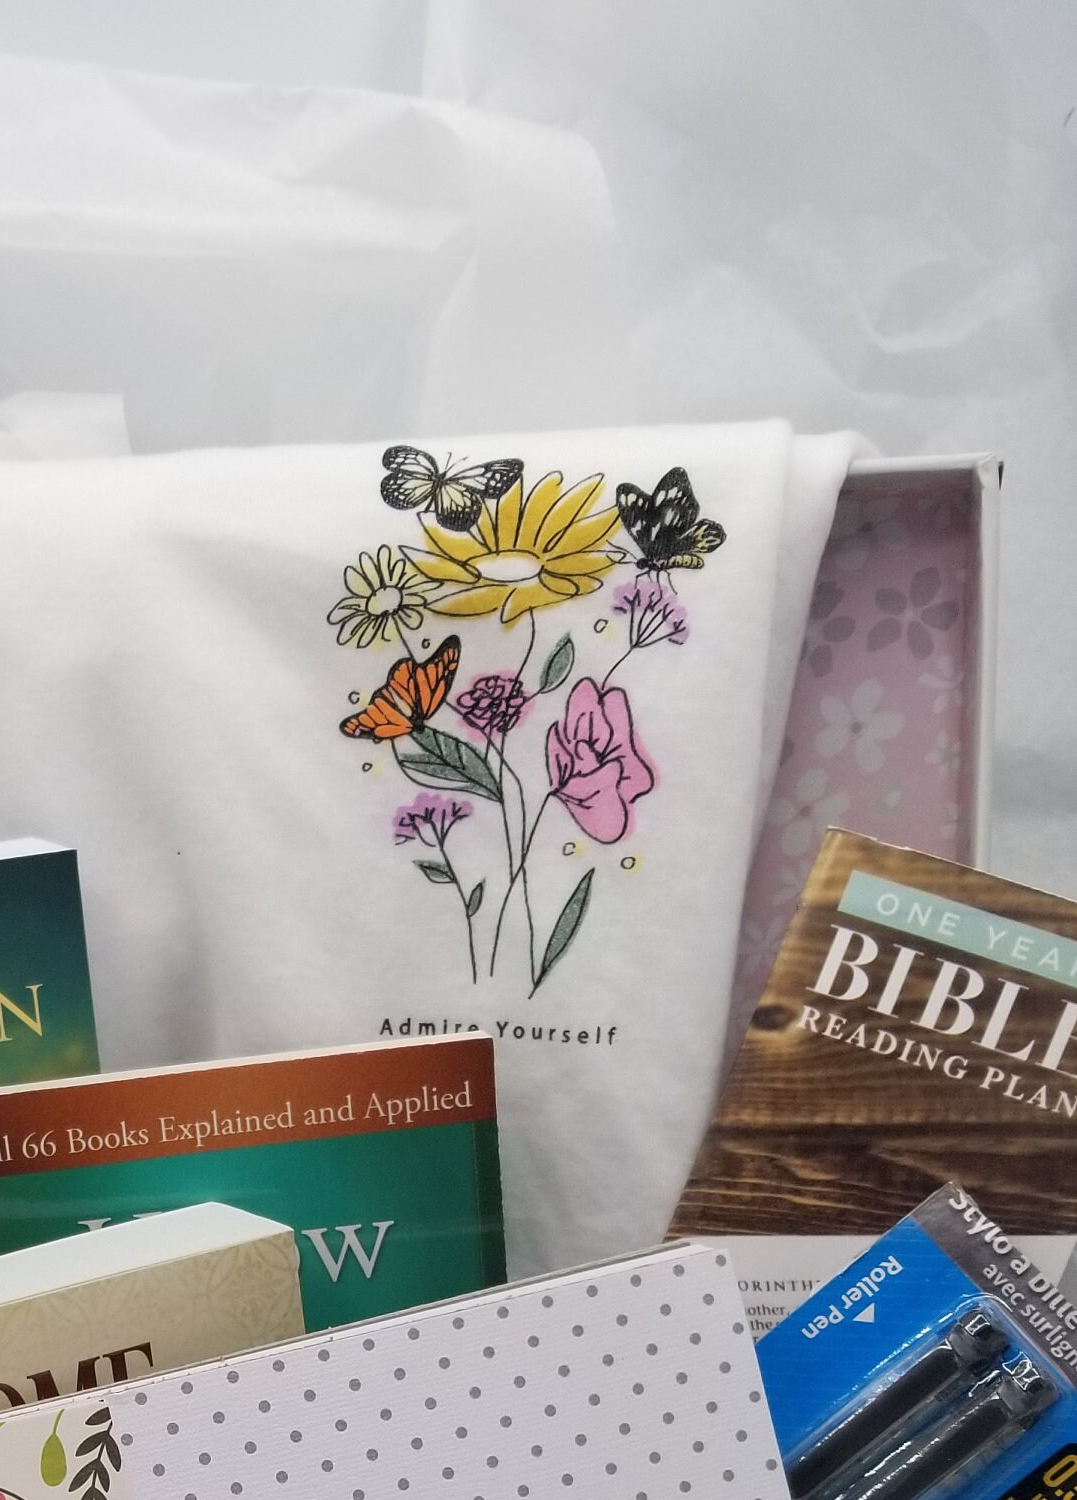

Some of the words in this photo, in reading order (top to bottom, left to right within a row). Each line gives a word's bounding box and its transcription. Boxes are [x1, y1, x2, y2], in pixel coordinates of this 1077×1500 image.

[876, 893, 961, 936] ONE
[379, 1018, 480, 1036] Admire
[495, 1021, 618, 1046] Yourself
[796, 1005, 970, 1080] READING
[22, 1128, 58, 1159] 66
[66, 1121, 149, 1156] Books
[157, 1101, 295, 1148] Explained
[303, 1095, 354, 1127] and
[364, 1081, 473, 1125] Applied
[737, 1280, 820, 1292] ORINTH
[841, 1255, 904, 1310] Roller
[801, 1304, 845, 1339] Pen
[982, 1263, 1025, 1306] avec
[1020, 1303, 1077, 1373] surlign
